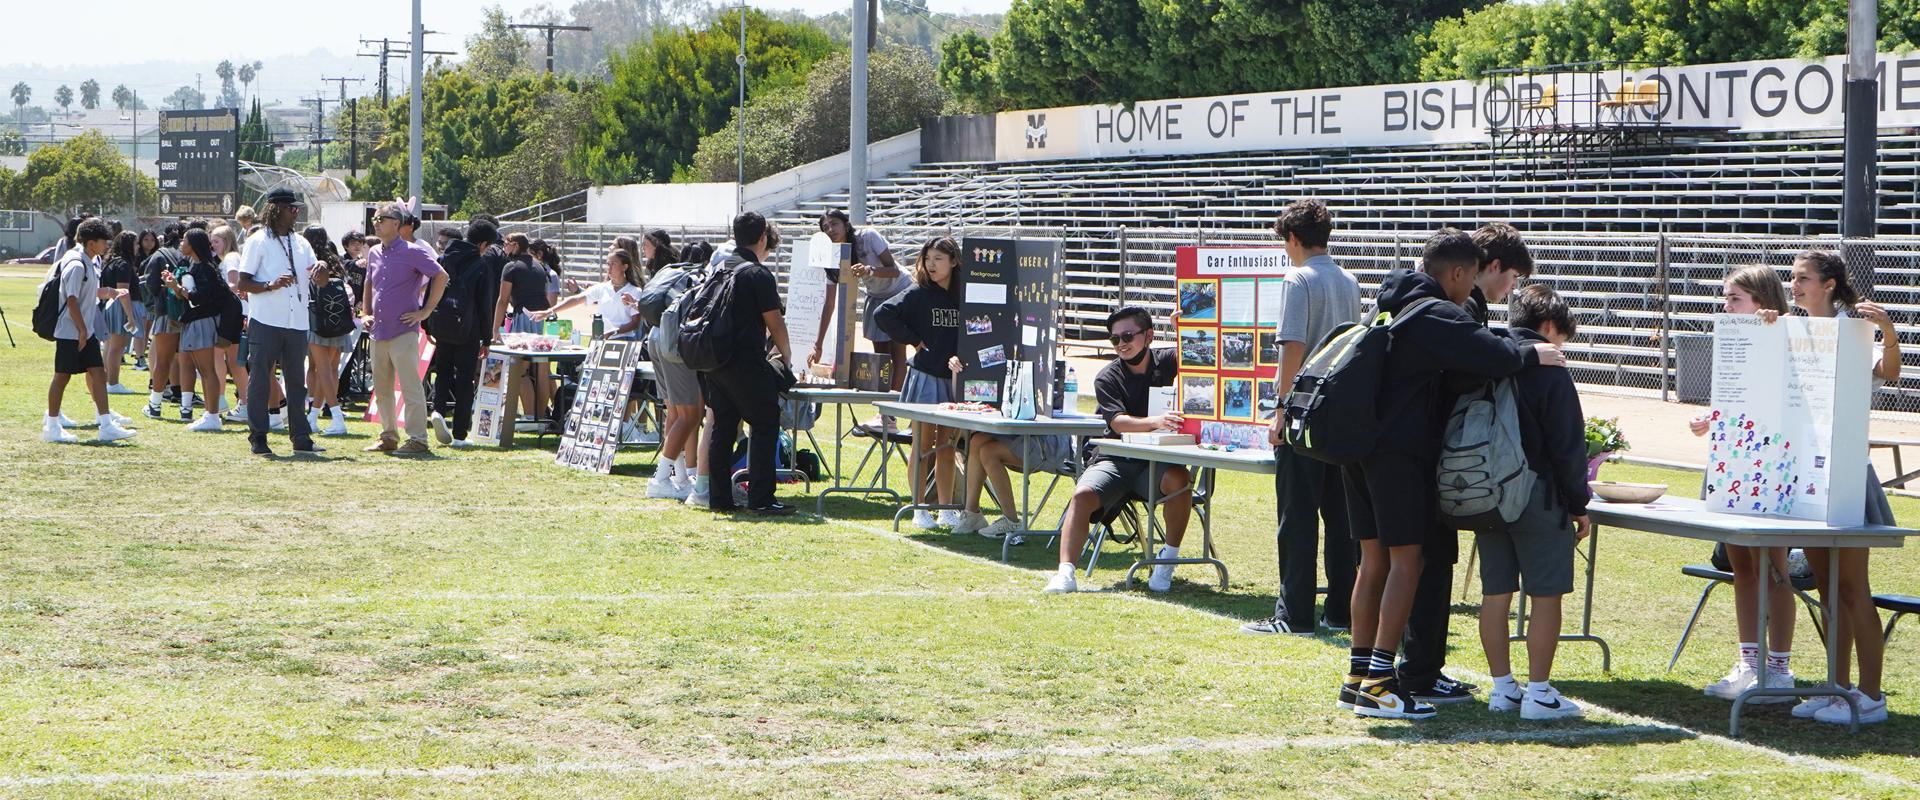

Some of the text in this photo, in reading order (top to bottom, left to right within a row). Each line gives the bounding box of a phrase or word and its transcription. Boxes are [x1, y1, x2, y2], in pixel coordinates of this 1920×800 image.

[1096, 104, 1182, 144] HOME
[1207, 100, 1249, 138] OF
[1270, 95, 1341, 135] THE
[1384, 82, 1544, 132] BISHOP
[161, 140, 173, 148] BALL
[210, 138, 220, 147] OUT
[196, 151, 200, 159] 4
[202, 151, 207, 159] 5
[215, 151, 219, 159] 7
[161, 162, 178, 171] GUEST
[162, 179, 177, 188] HOME
[1019, 256, 1048, 269] CHEER 4
[1207, 255, 1224, 267] Car
[1228, 255, 1277, 267] Enthusiast
[970, 270, 1001, 279] Background
